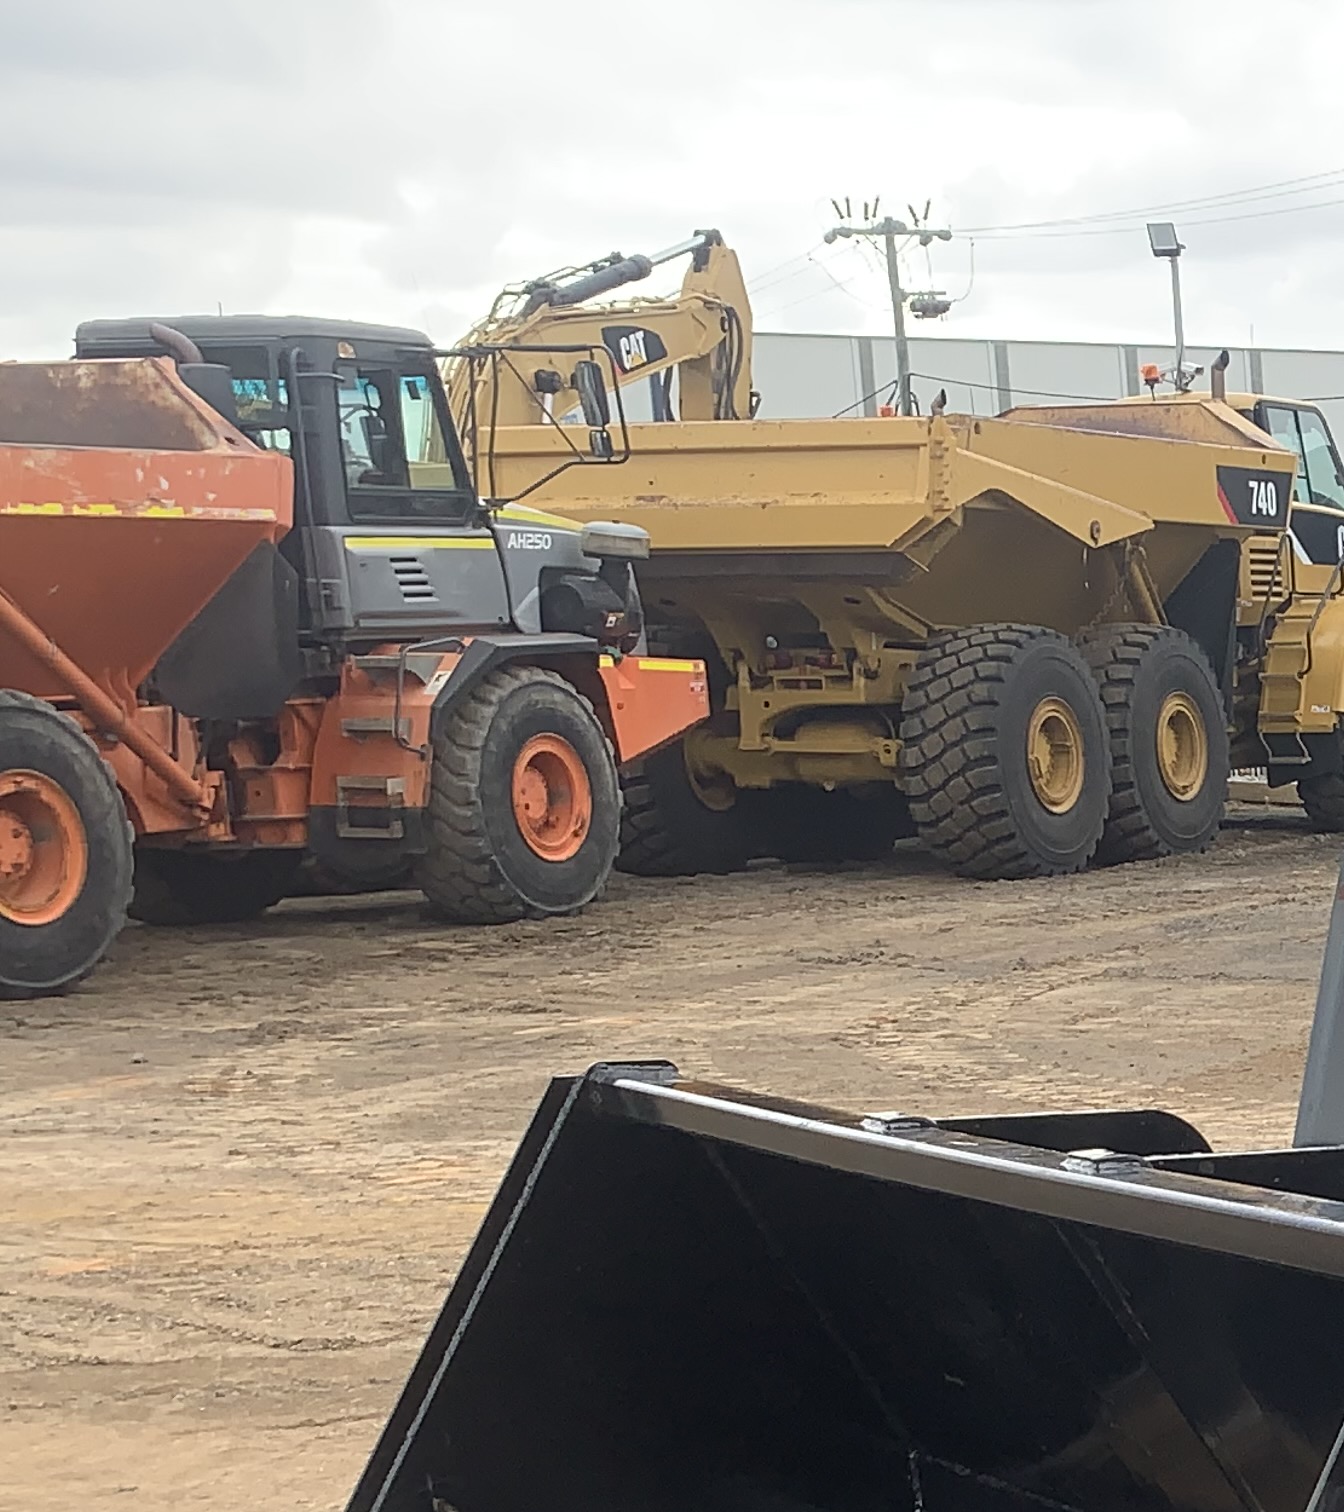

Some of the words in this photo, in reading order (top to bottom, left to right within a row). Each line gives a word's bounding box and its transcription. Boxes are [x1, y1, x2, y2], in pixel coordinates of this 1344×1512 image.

[619, 330, 648, 371] CAT
[1248, 480, 1278, 517] 740
[507, 532, 552, 550] AH250
